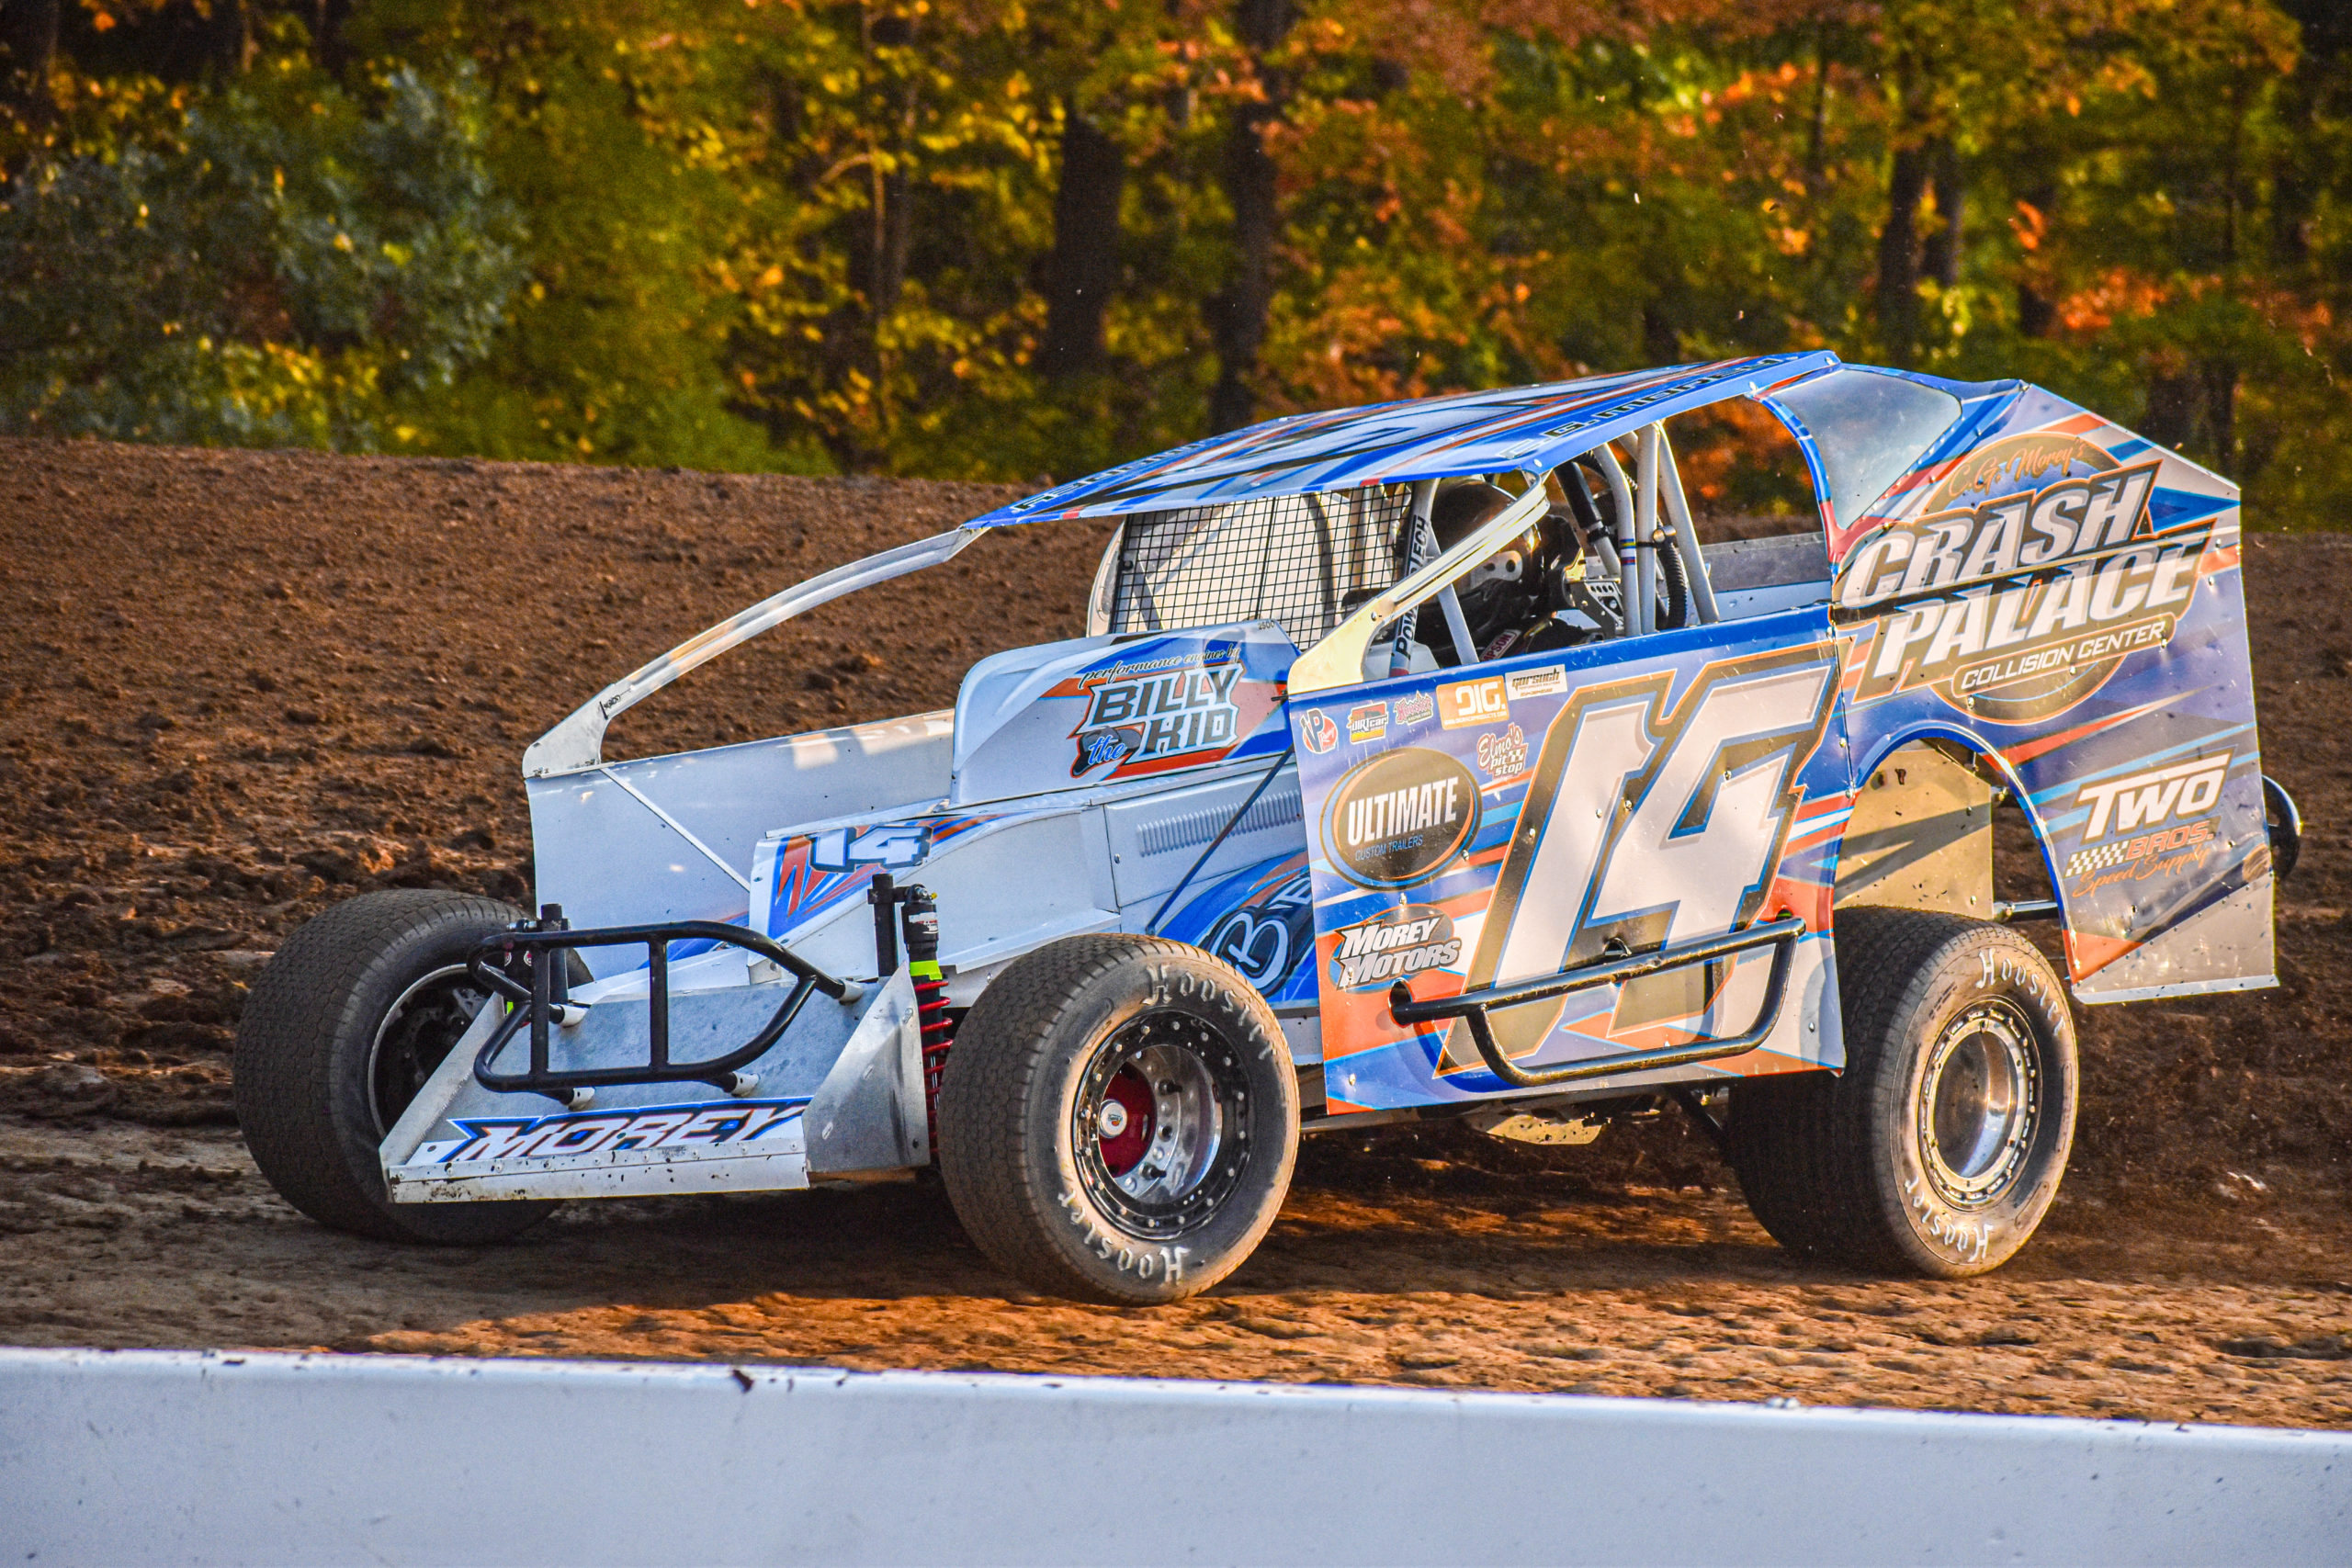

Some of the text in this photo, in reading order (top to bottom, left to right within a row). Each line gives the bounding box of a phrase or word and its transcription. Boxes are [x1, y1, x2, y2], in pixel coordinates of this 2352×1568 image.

[1840, 471, 2153, 609] CRASH
[1872, 542, 2209, 679] PALACE
[1078, 642, 1242, 690] performance engines by
[1961, 620, 2165, 689] COLLISION CENTER
[1091, 668, 1238, 726] BILLY
[1088, 734, 1126, 766] the
[1143, 707, 1235, 755] KID
[1300, 708, 1325, 753] VP
[1478, 724, 1523, 767] Elmo's
[1490, 754, 1508, 769] pit
[1495, 761, 1523, 776] stop
[1347, 777, 1459, 846] ULTIMATE
[2078, 752, 2232, 840] TWO
[809, 826, 928, 869] 14
[1355, 834, 1424, 862] CUSTOM TRAILERS
[1488, 665, 1832, 992] 14
[2126, 820, 2214, 861] BROS.
[2072, 842, 2211, 898] Speed Supply
[1339, 919, 1442, 959] MOREY
[1338, 941, 1461, 989] MOTORS
[458, 1106, 806, 1161] MOREY
